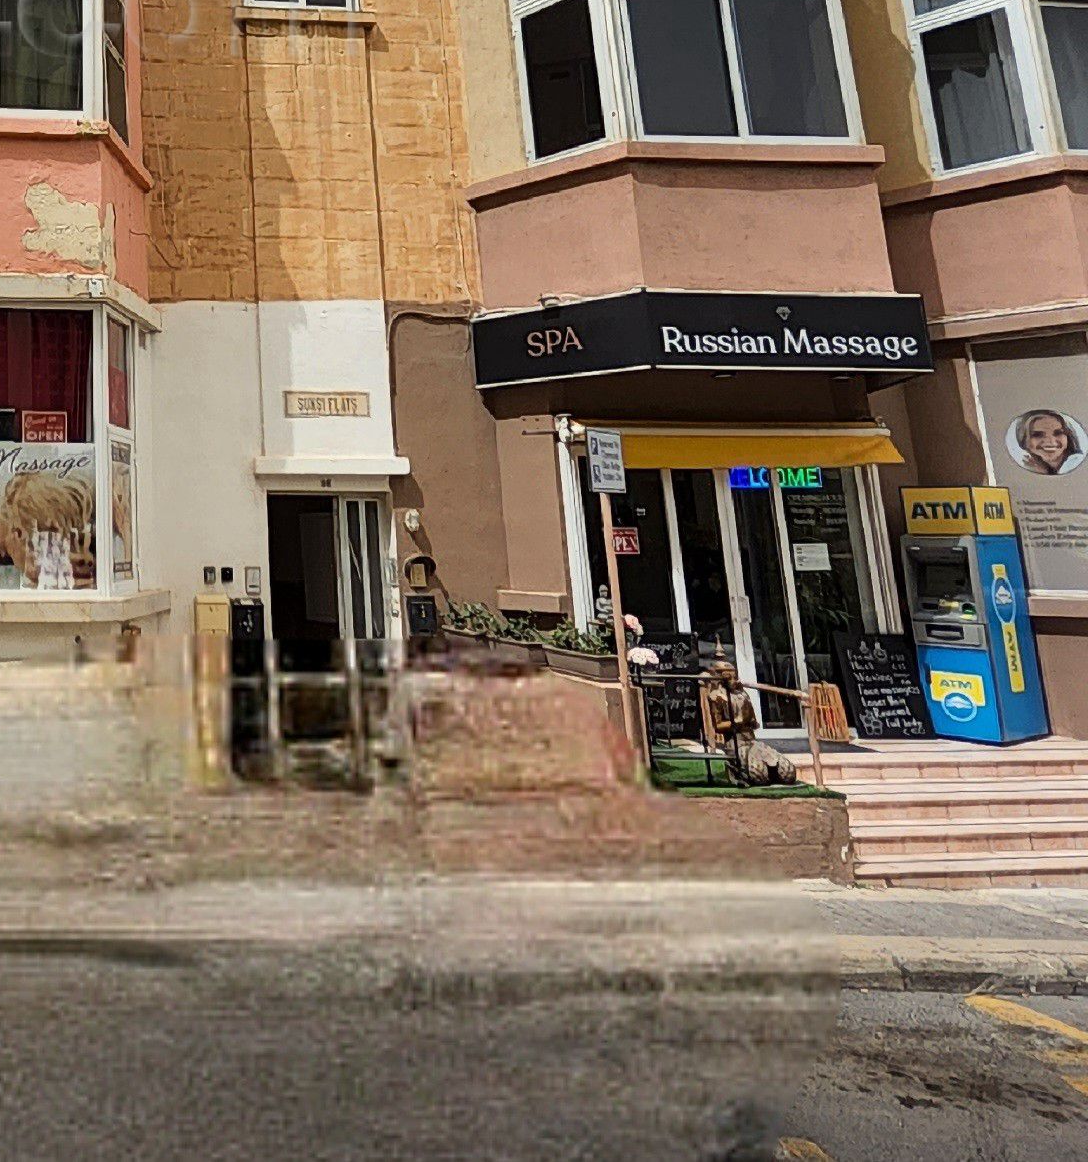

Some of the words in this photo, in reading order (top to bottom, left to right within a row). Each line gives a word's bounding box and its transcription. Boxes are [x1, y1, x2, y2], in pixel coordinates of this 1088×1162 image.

[527, 326, 583, 357] SPA
[662, 325, 778, 355] Russian
[783, 328, 919, 360] Massage
[25, 430, 64, 441] OPEN
[912, 501, 968, 520] ATM
[983, 501, 1006, 520] ATM
[940, 678, 972, 690] ATM
